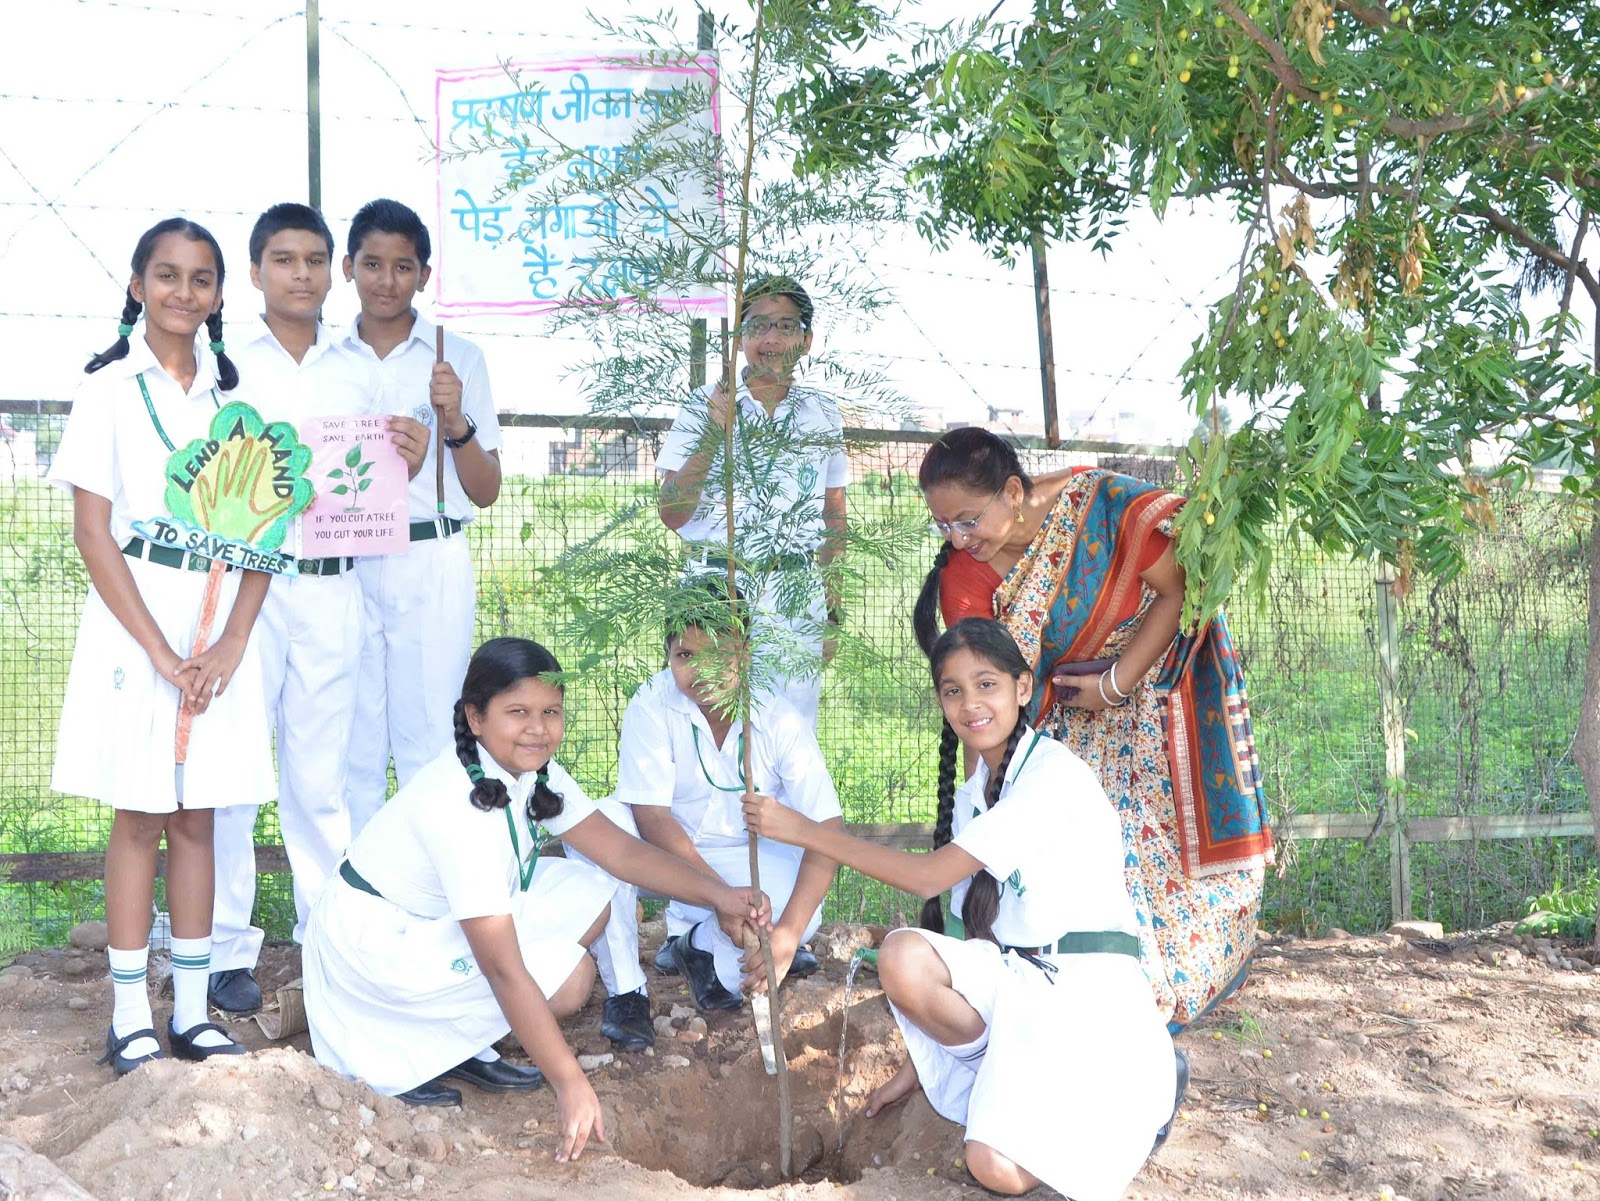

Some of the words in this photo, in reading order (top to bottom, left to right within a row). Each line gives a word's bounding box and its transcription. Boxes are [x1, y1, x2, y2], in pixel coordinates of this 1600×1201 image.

[552, 73, 634, 123] जीवन
[450, 188, 512, 250] पेड़
[517, 188, 620, 244] लगाओ
[522, 244, 564, 299] हैं
[323, 421, 346, 429] SAVE
[355, 433, 384, 441] EARTH
[171, 440, 220, 493] LEND
[227, 416, 246, 442] A
[257, 424, 295, 499] HAND
[314, 531, 331, 539] YOU
[352, 529, 374, 538] YOUR
[375, 528, 395, 537] LIFE
[315, 515, 324, 523] IF
[330, 514, 347, 523] YOU
[154, 520, 178, 544] TO
[185, 532, 236, 561] SAVE
[239, 547, 288, 574] TREES
